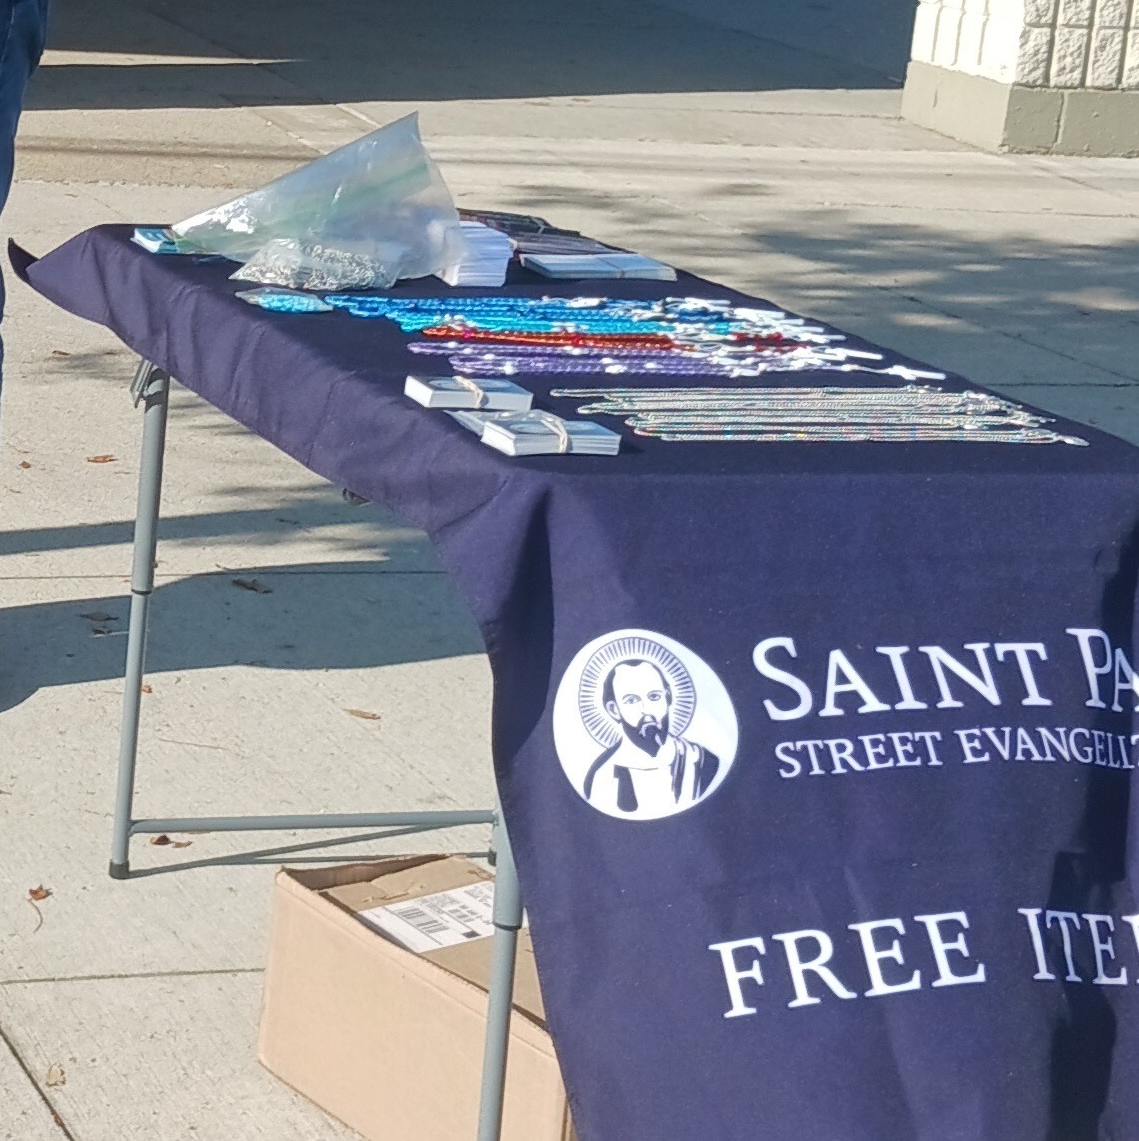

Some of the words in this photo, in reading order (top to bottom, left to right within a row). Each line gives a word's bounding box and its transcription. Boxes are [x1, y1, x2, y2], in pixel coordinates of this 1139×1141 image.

[774, 731, 944, 778] STREET
[953, 726, 1139, 769] EVANGELI
[708, 911, 986, 1018] FREE
